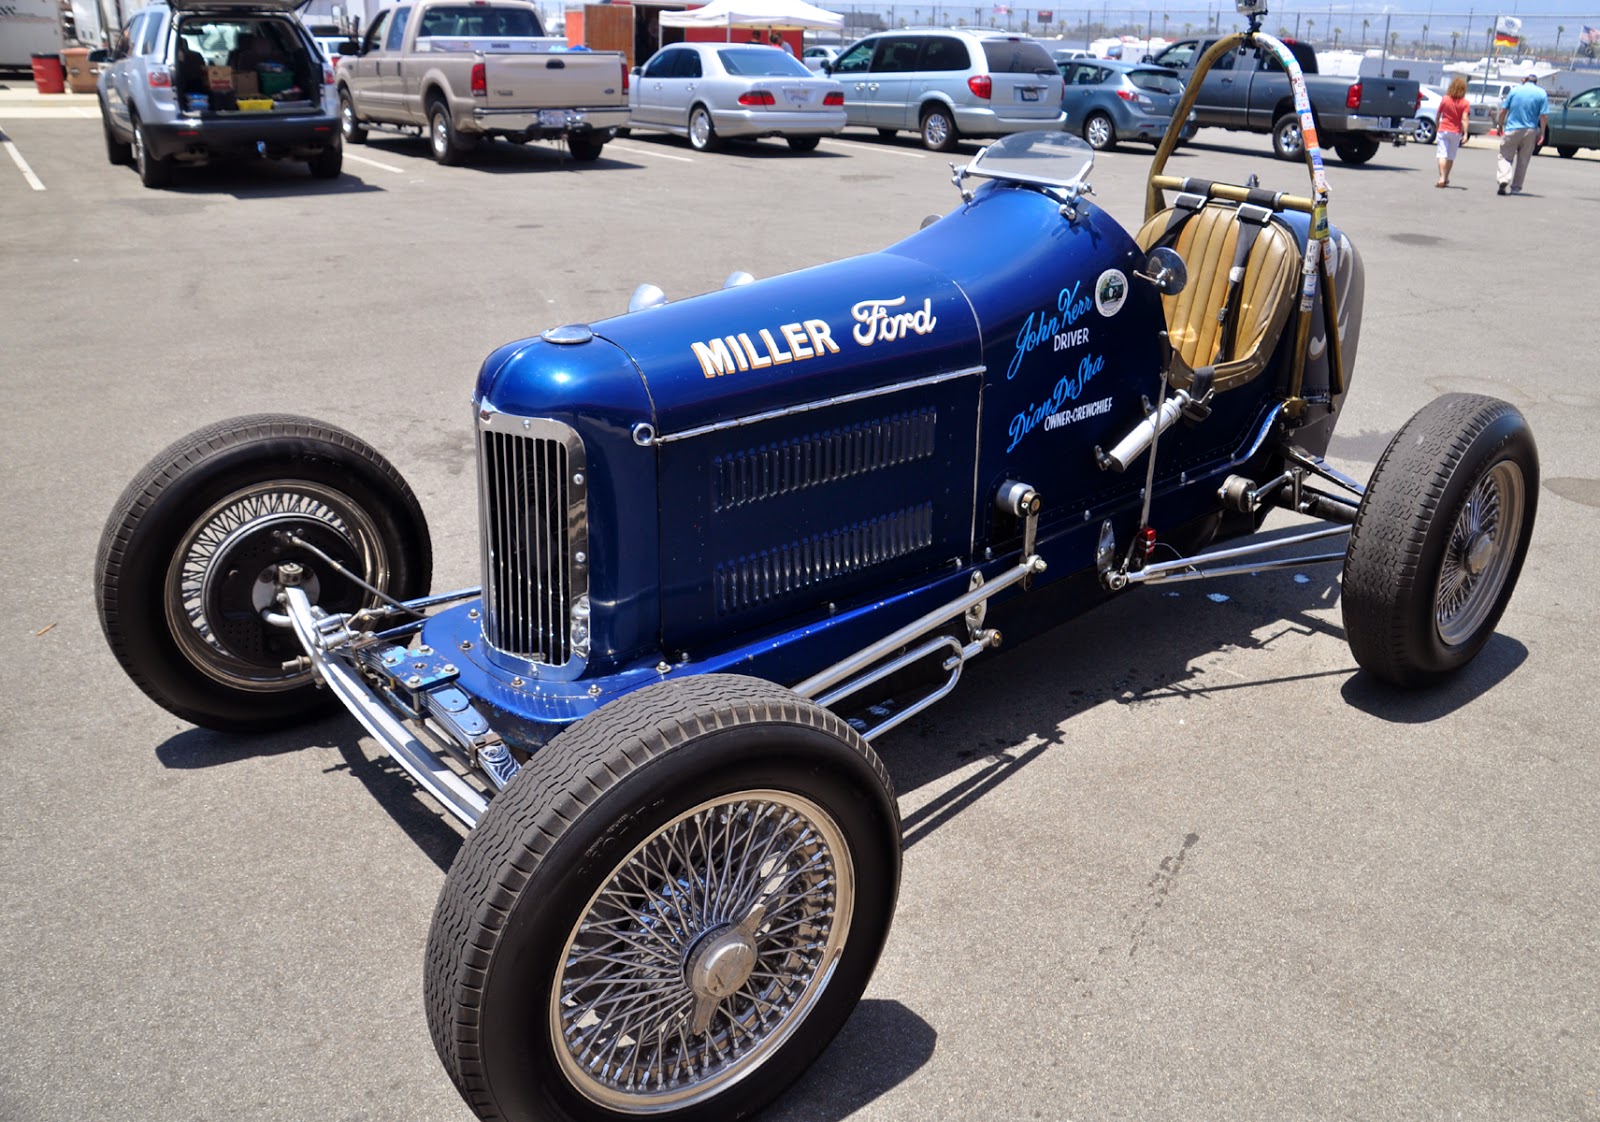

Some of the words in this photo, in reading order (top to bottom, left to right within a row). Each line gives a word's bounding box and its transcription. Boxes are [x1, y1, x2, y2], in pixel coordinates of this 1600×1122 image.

[690, 318, 840, 379] MILLER
[851, 295, 937, 347] Ford
[1007, 311, 1060, 380] John
[1058, 280, 1093, 329] Kerr
[1053, 327, 1090, 352] DRIVER
[1006, 397, 1053, 454] Dian
